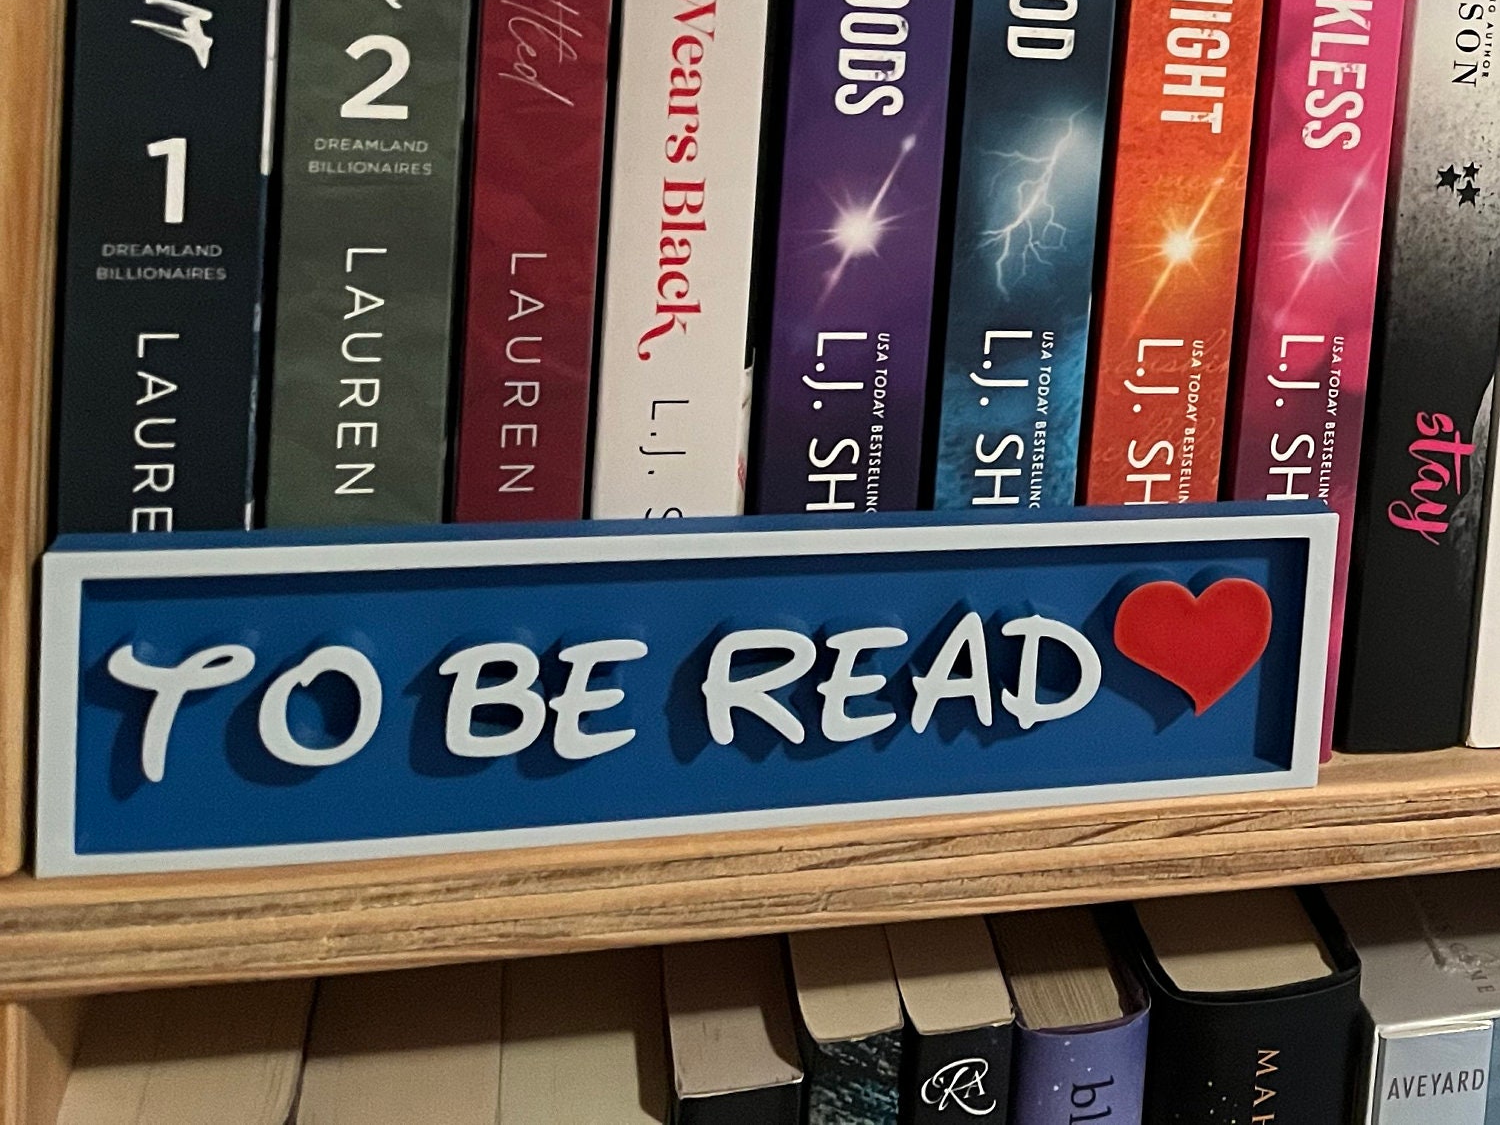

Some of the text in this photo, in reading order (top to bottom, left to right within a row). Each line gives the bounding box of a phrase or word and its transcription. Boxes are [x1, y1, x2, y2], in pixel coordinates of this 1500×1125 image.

[340, 34, 411, 120] 2
[1481, 22, 1494, 78] AUTHOR
[147, 137, 187, 224] 1
[308, 160, 432, 176] BILLIONAIRES
[313, 137, 428, 154] DREAMLAND
[96, 266, 227, 281] BILLIONAIRES
[101, 242, 222, 258] DREAMLAND
[636, 177, 708, 363] Black
[334, 247, 387, 496] LAUREN
[498, 252, 548, 493] LAUREN
[801, 331, 868, 410] L.J.
[871, 332, 891, 420] USA TODAY
[969, 329, 1033, 407] L.J.
[1034, 331, 1055, 416] USA TODAY
[1123, 338, 1185, 413] L.J.
[1185, 339, 1204, 422] USA TODAY
[1267, 334, 1325, 408] L.J.
[1326, 336, 1345, 417] USA TODAY
[1387, 411, 1476, 546] stay
[107, 612, 1104, 784] TO BE READ
[1386, 1068, 1485, 1100] AVEYARD
